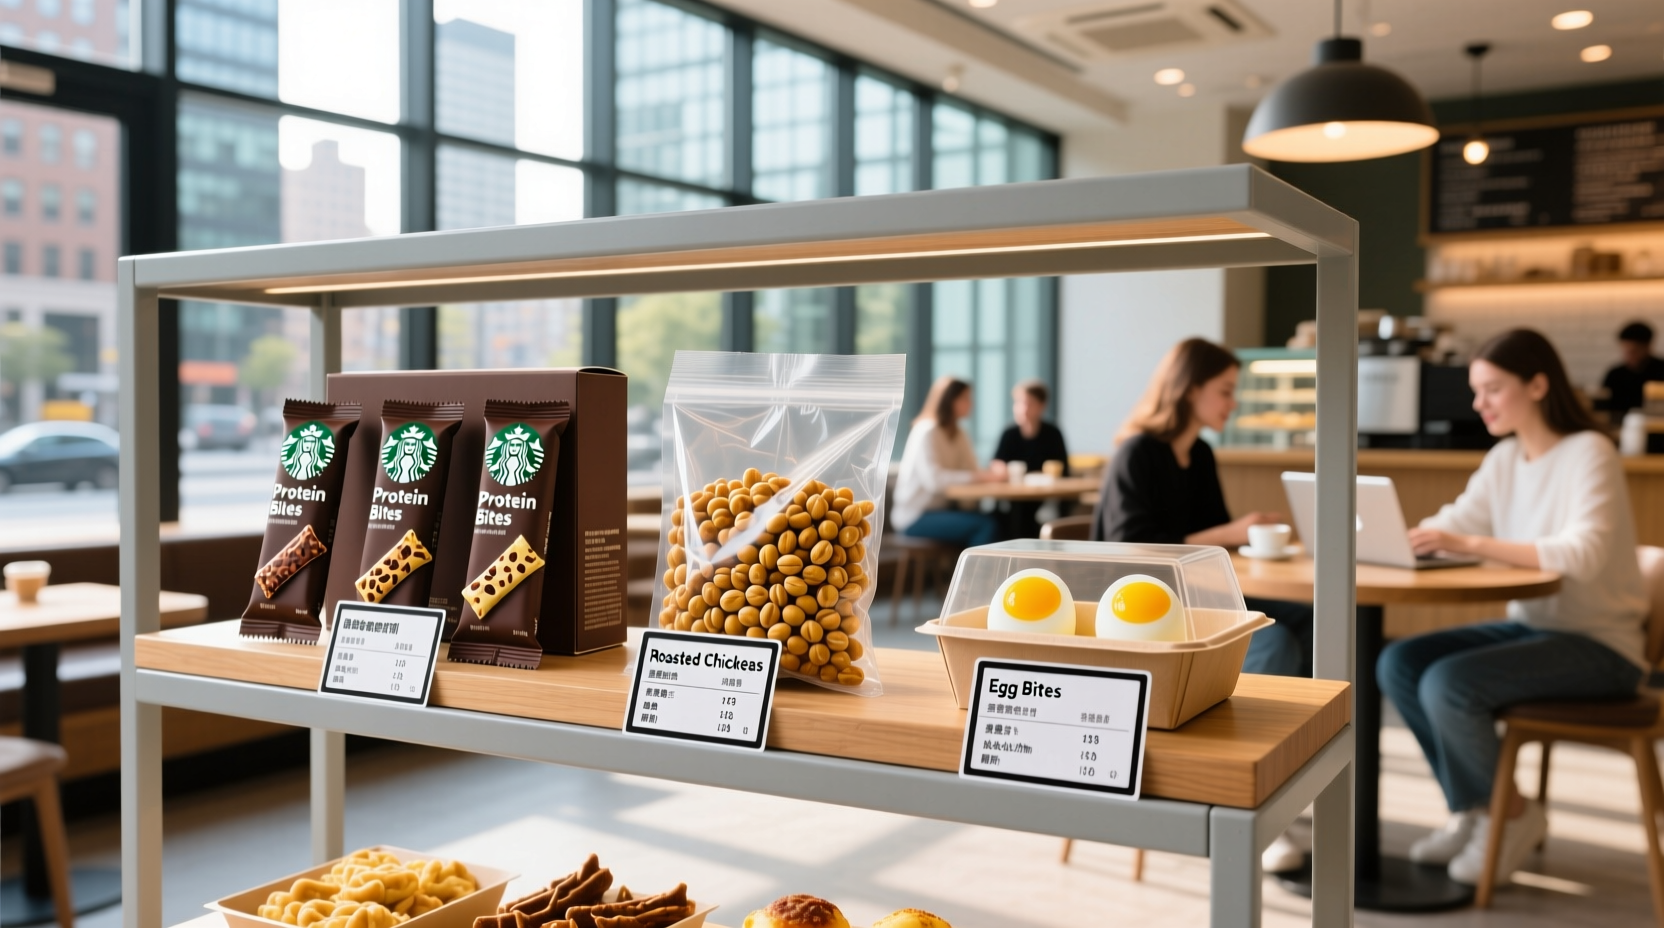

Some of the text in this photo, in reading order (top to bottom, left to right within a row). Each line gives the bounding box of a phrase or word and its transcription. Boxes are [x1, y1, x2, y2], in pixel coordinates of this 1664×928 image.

[272, 483, 326, 502] Protein
[372, 486, 429, 506] Protein
[477, 491, 537, 510] Protein
[269, 500, 303, 517] Bites
[369, 504, 402, 521] Bites
[475, 508, 512, 526] Bites
[649, 648, 701, 666] Roasted
[989, 678, 1062, 699] Egg Bites
